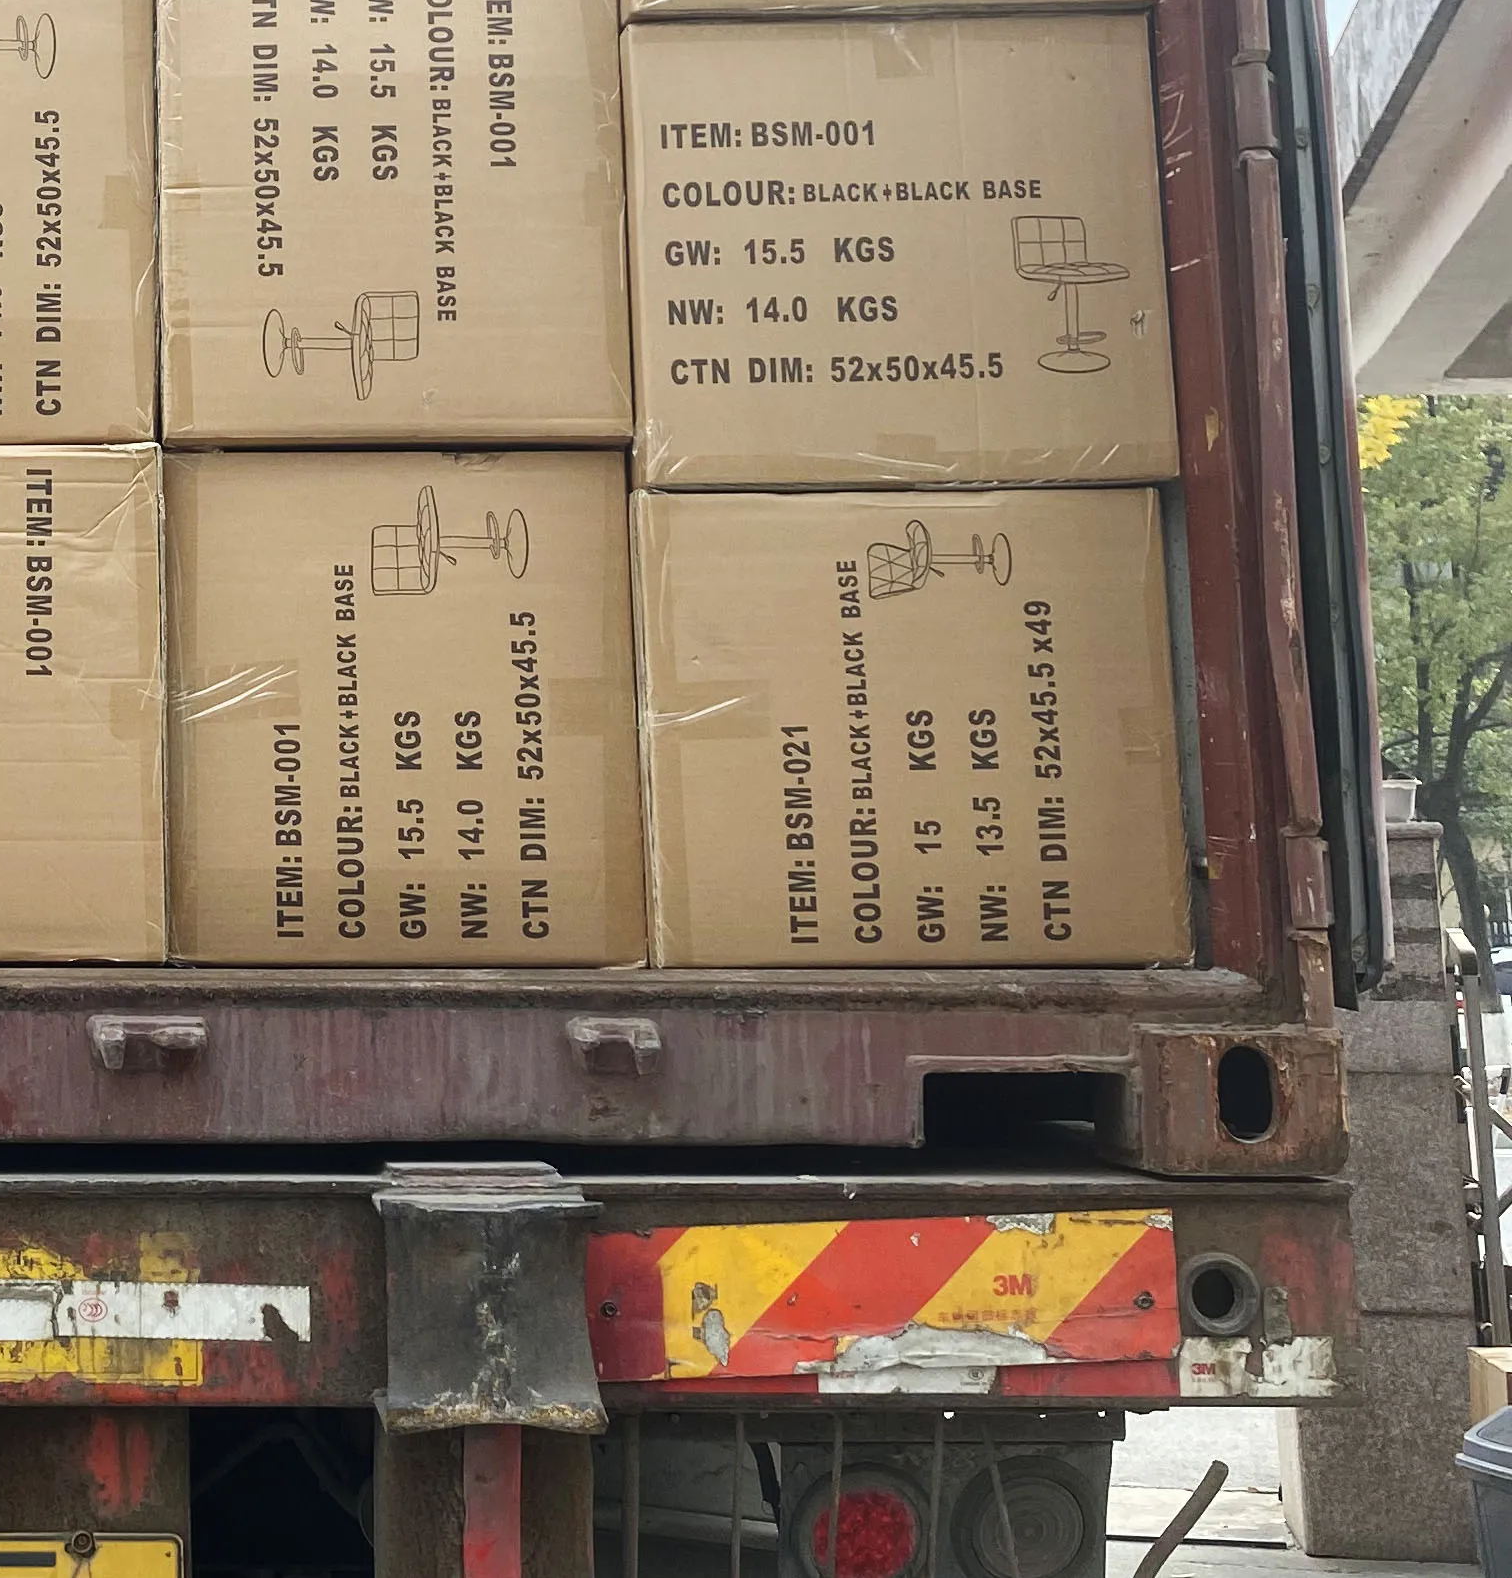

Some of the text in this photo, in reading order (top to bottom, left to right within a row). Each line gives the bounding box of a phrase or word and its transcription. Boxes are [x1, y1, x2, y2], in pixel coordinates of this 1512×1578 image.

[251, 44, 278, 102] DIM:
[311, 43, 338, 98] 14.0
[311, 125, 339, 182] KGS
[252, 117, 283, 277] 52x50x45.5
[34, 109, 62, 415] CTN DIM: 52x50x45.5
[664, 236, 895, 267] GW: 15.5 KGS
[670, 351, 1003, 385] CTN DIM: 52x50x45.5
[836, 559, 861, 618] BASE
[509, 611, 549, 939] CTN DIM: 52x50x45.5
[393, 710, 427, 939] GW: 15.5 KGS
[905, 708, 946, 942] GW: 15 KGS
[968, 707, 1009, 941] NW: 13.5 KGS
[1037, 796, 1067, 861] DIM:
[1041, 880, 1072, 941] CTN
[992, 1273, 1034, 1297] 3M
[1191, 1363, 1216, 1376] 3M
